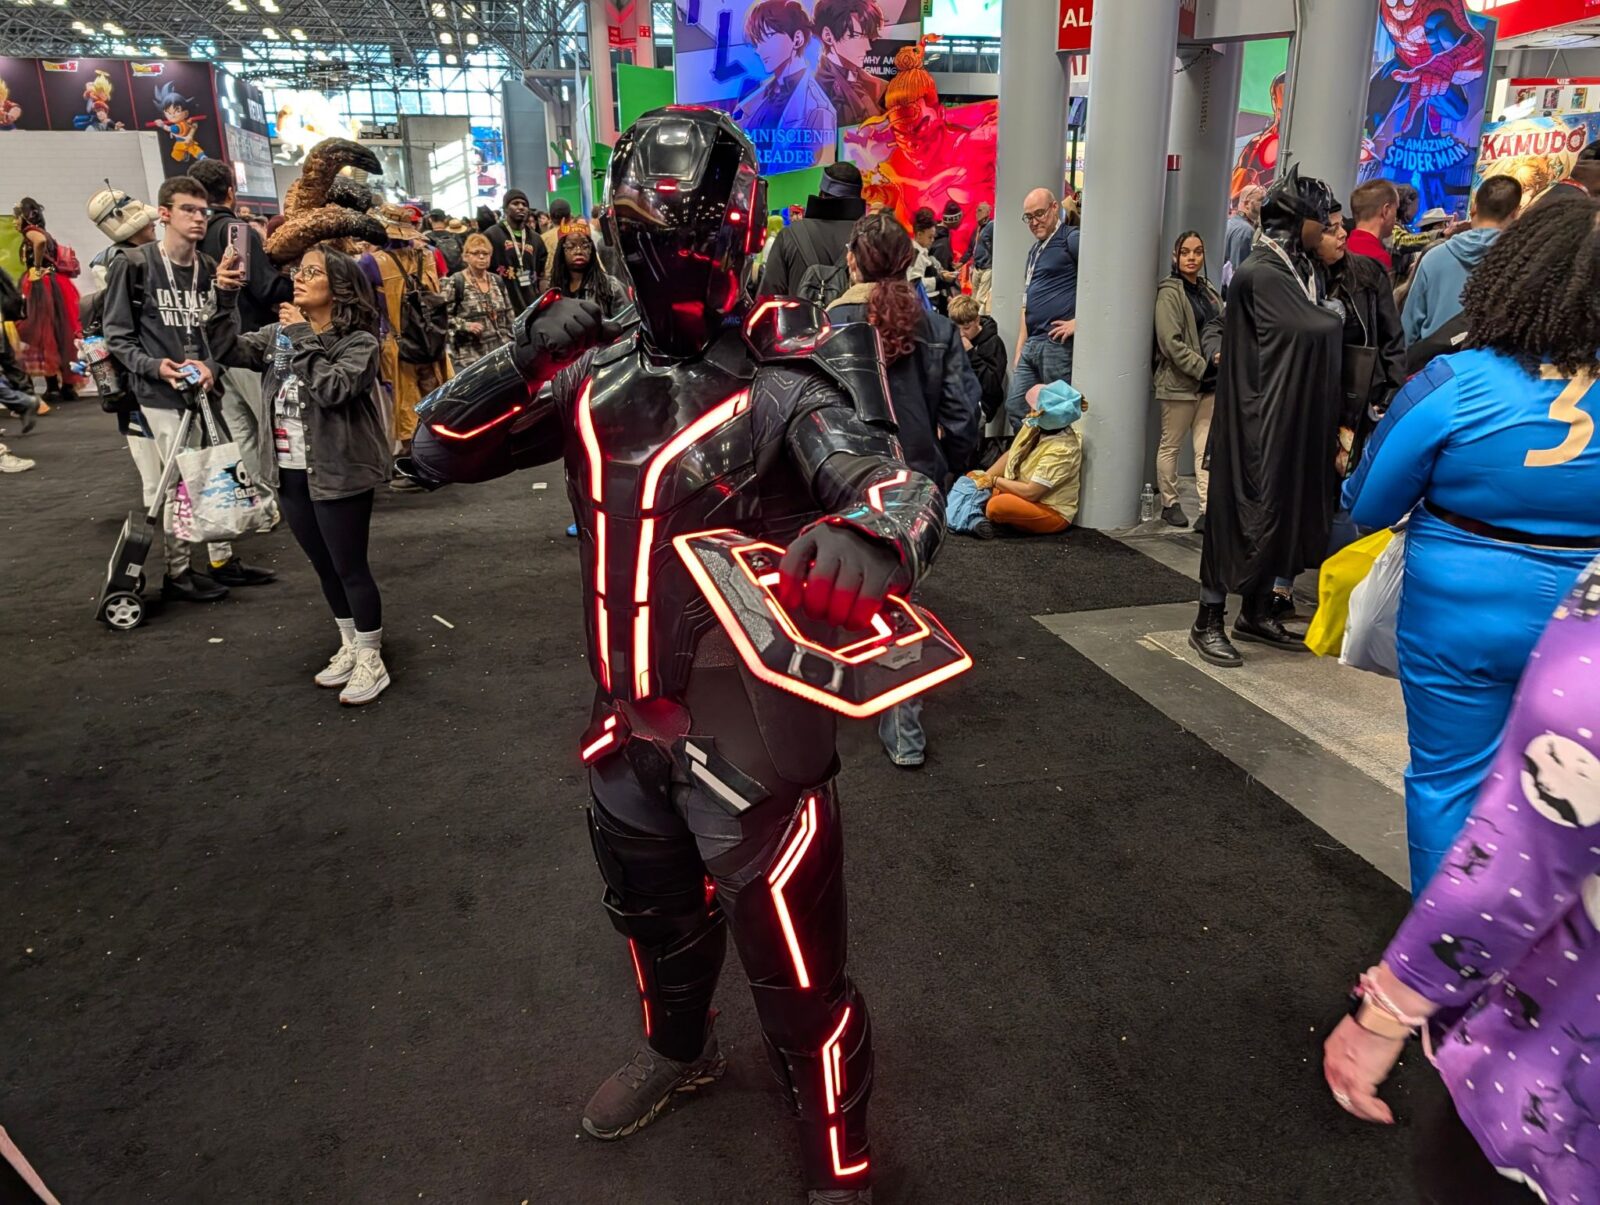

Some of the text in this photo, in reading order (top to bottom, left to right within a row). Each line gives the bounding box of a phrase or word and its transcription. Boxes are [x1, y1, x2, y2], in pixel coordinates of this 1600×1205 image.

[1062, 7, 1093, 29] AL
[865, 66, 897, 75] SMILING
[744, 129, 834, 143] MNISCIENT
[1405, 136, 1454, 152] AMAZING
[1480, 123, 1586, 161] KAMUDO
[1385, 143, 1469, 172] SPIDER-MAN
